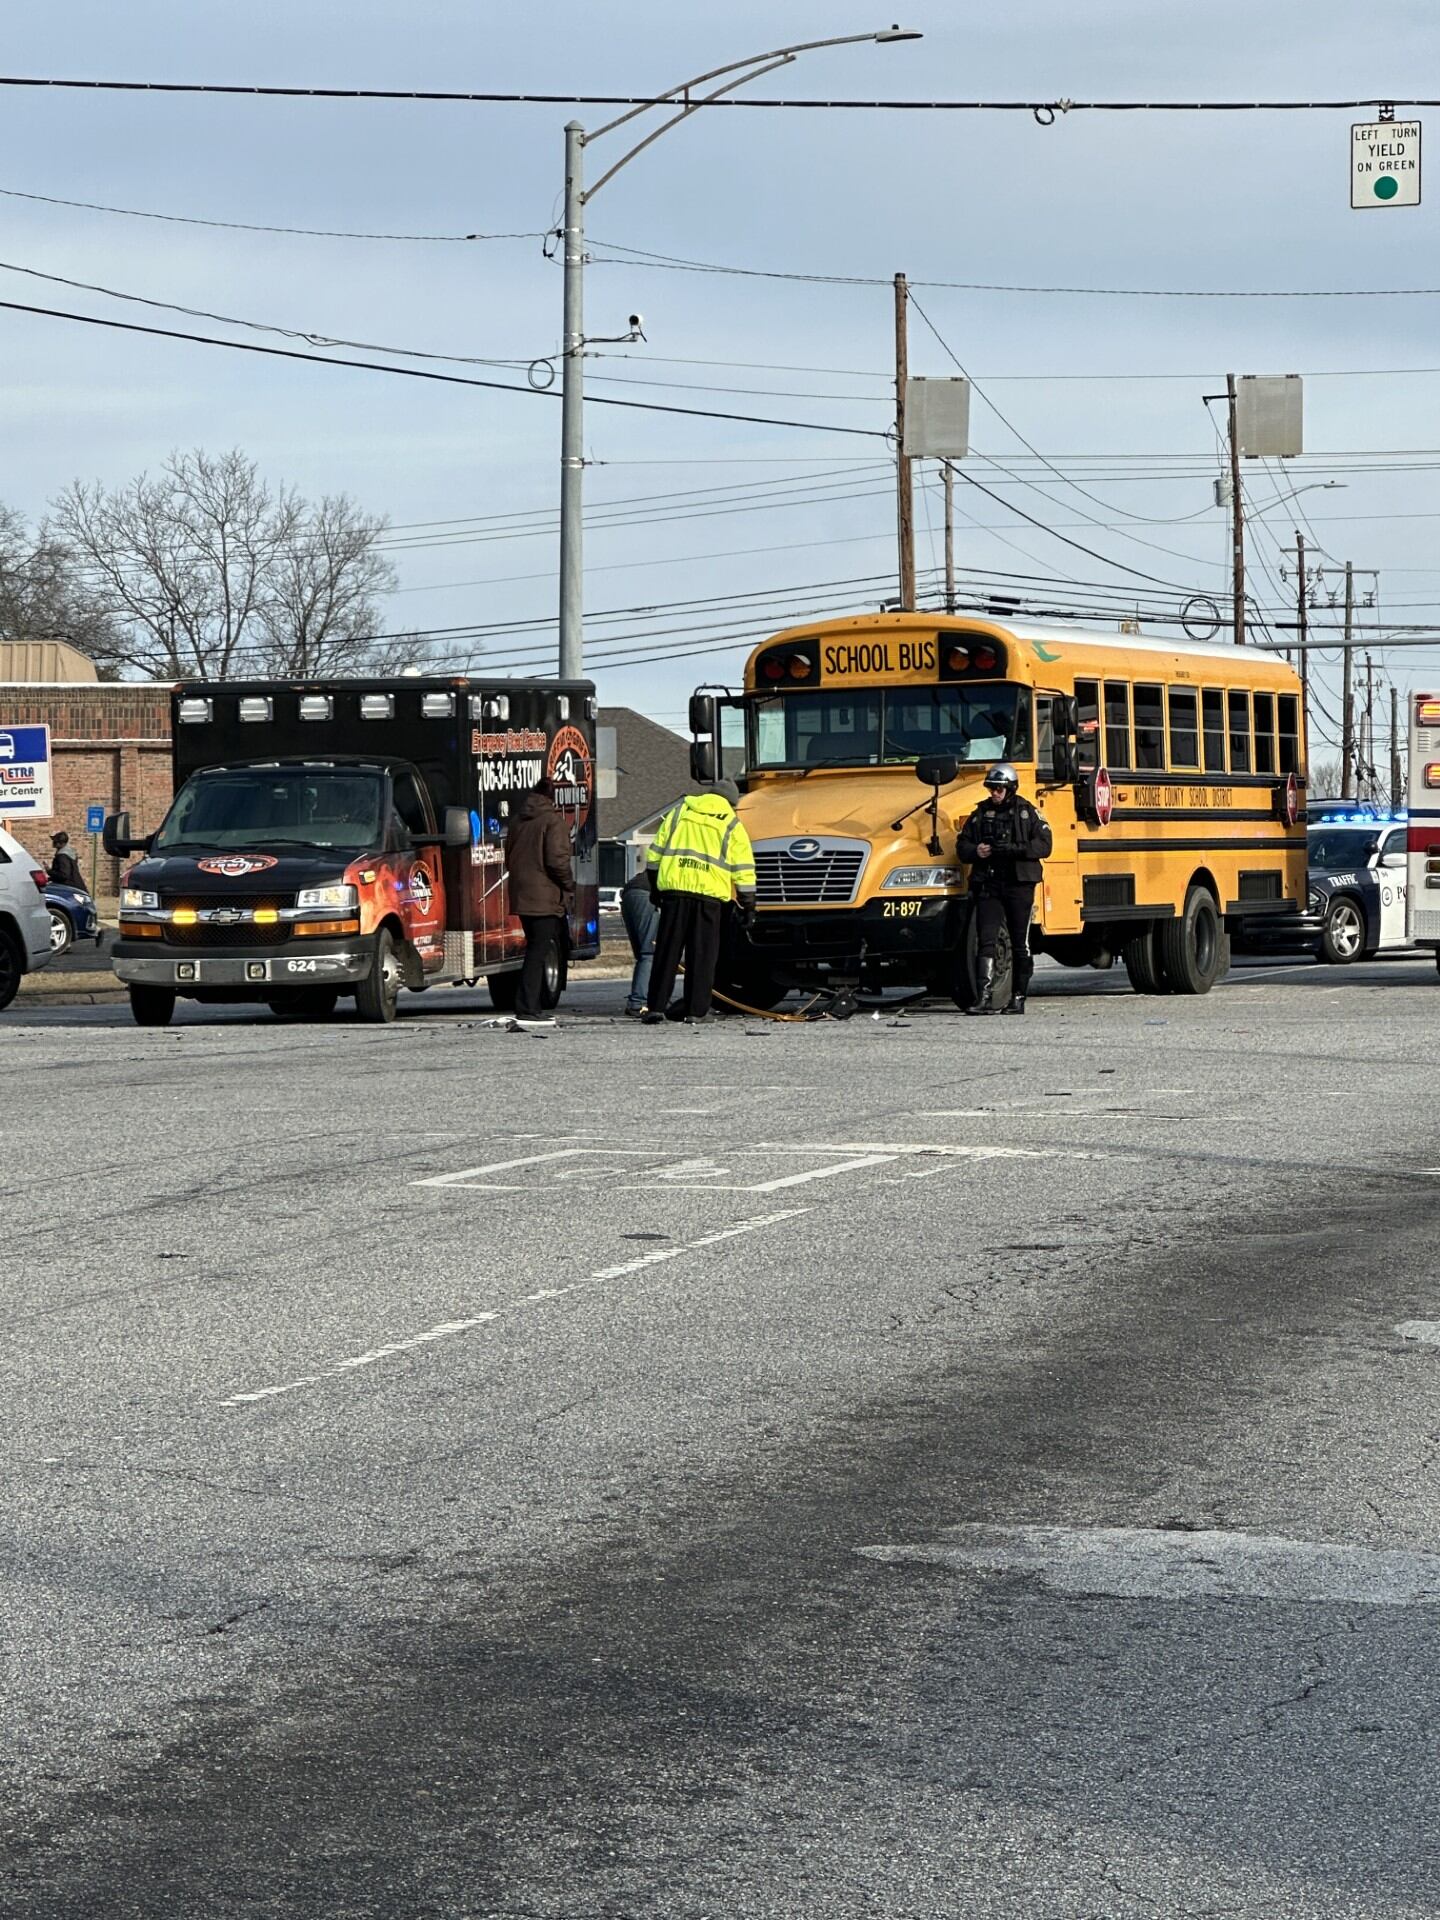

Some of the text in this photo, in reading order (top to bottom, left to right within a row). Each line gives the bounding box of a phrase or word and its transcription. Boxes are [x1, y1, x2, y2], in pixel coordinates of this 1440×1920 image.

[1355, 127, 1417, 141] LEFT TURN
[1368, 143, 1405, 157] YIELD
[1357, 160, 1415, 172] ON GREEN
[825, 641, 935, 675] SCHOOL BUS
[477, 759, 542, 791] 706-341-3TOW
[10, 786, 43, 796] Center
[554, 787, 586, 808] TOWING
[1097, 786, 1109, 807] STOP
[1164, 787, 1184, 807] COUNTY
[1189, 787, 1209, 808] SCHOOL
[1212, 787, 1233, 807] DISTRICT
[1327, 873, 1359, 887] TRAFFIC
[883, 901, 922, 917] 21-897
[287, 960, 317, 972] 624
